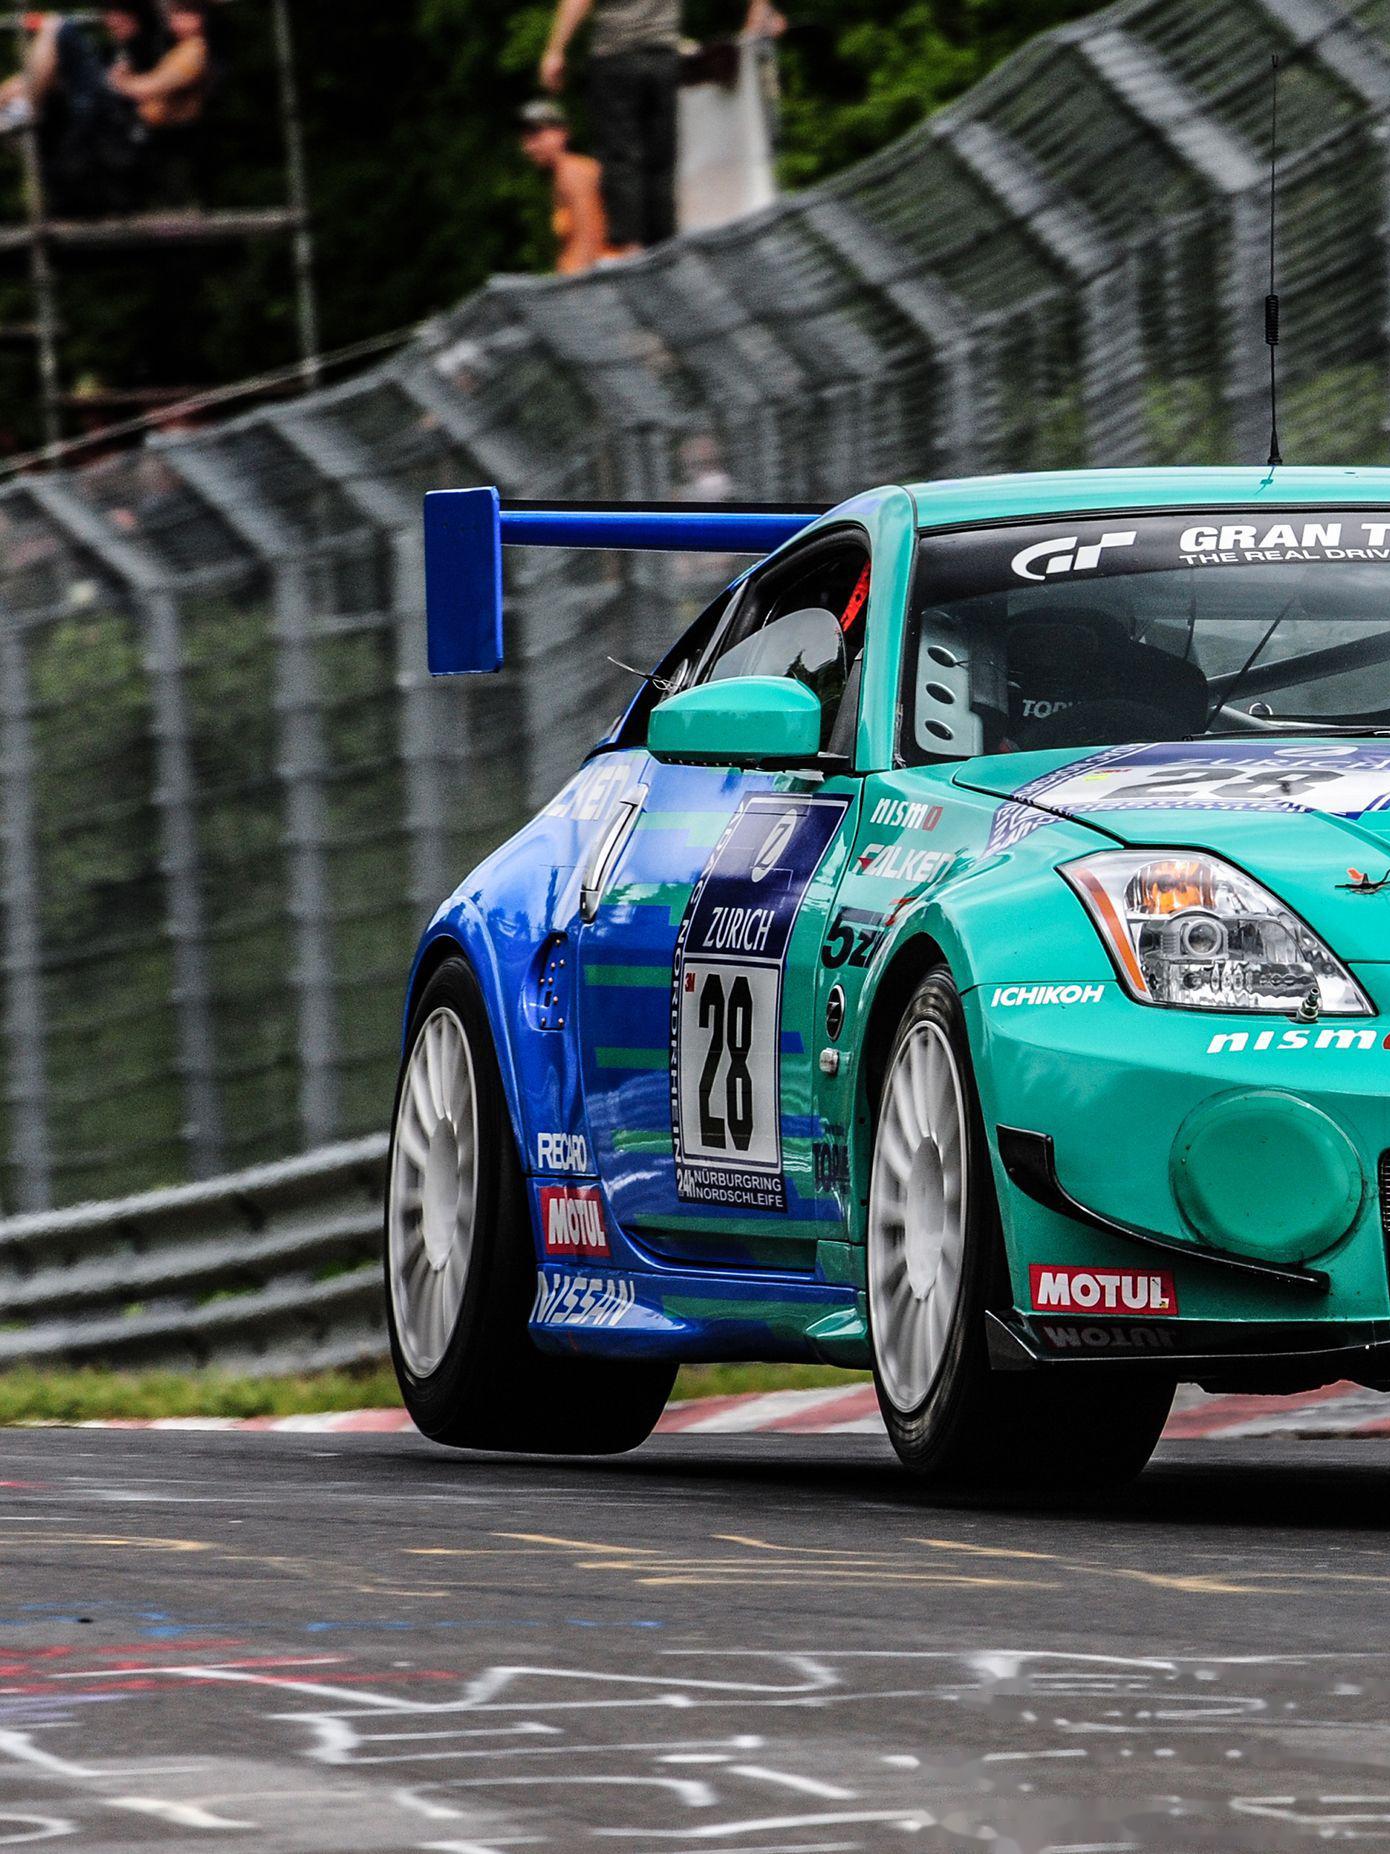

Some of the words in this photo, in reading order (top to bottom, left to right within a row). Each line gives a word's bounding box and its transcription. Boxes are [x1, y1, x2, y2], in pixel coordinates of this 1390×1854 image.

[1179, 523, 1342, 552] GRAN
[1178, 551, 1240, 565] THE
[1244, 550, 1320, 562] REAL
[1099, 768, 1346, 799] 28
[702, 907, 776, 951] ZURICH
[990, 984, 1105, 1008] ICHIKOH
[699, 973, 754, 1151] 28
[537, 1132, 588, 1173] RECARO
[694, 1168, 782, 1193] NÜRBURGRING
[696, 1185, 784, 1208] NORDSCHLEIFE
[548, 1197, 606, 1247] MOTUL
[529, 1271, 635, 1327] NISSAN
[1037, 1271, 1170, 1310] MOTUL
